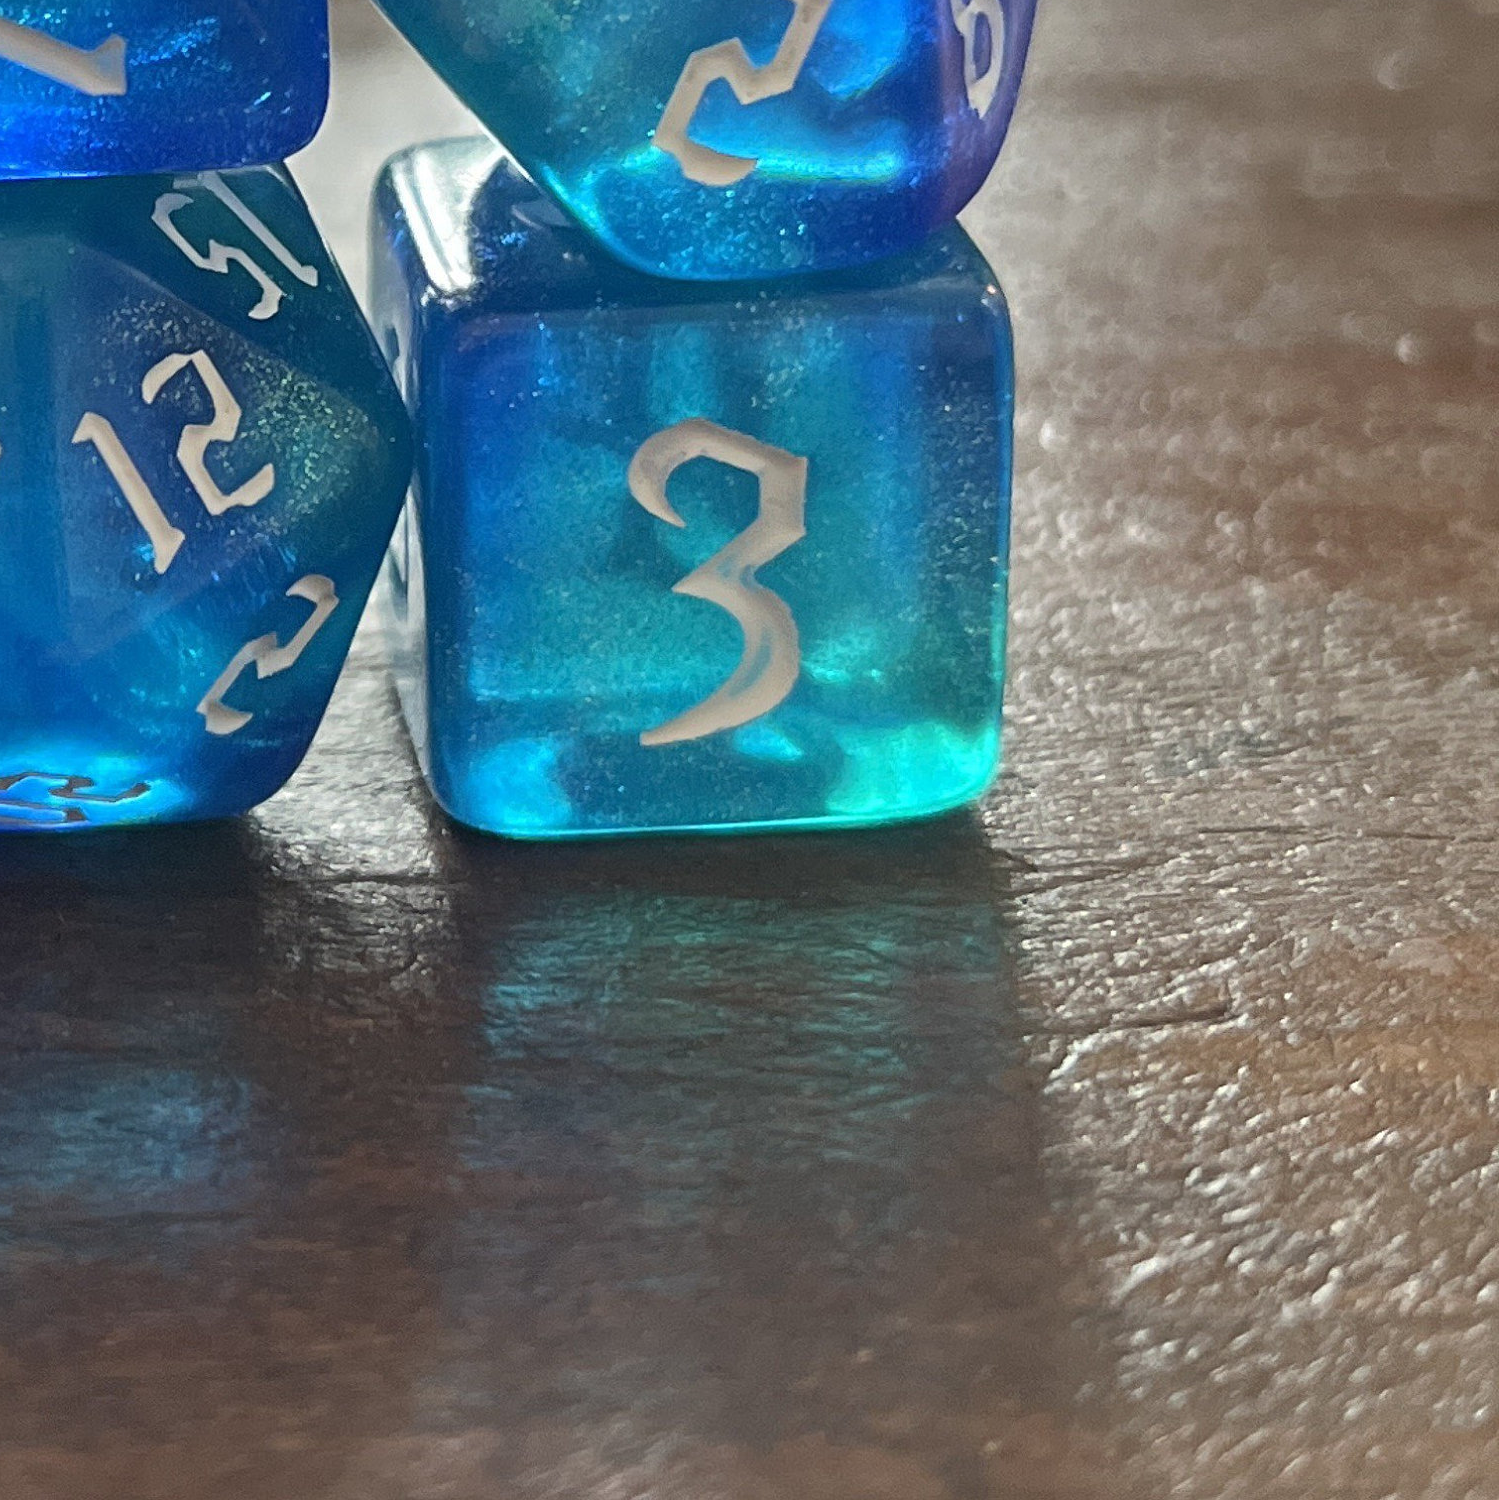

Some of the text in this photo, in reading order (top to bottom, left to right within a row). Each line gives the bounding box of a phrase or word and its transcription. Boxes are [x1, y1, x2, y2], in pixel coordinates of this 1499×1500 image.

[72, 350, 275, 574] 12
[196, 575, 339, 736] 2
[628, 417, 808, 747] 3
